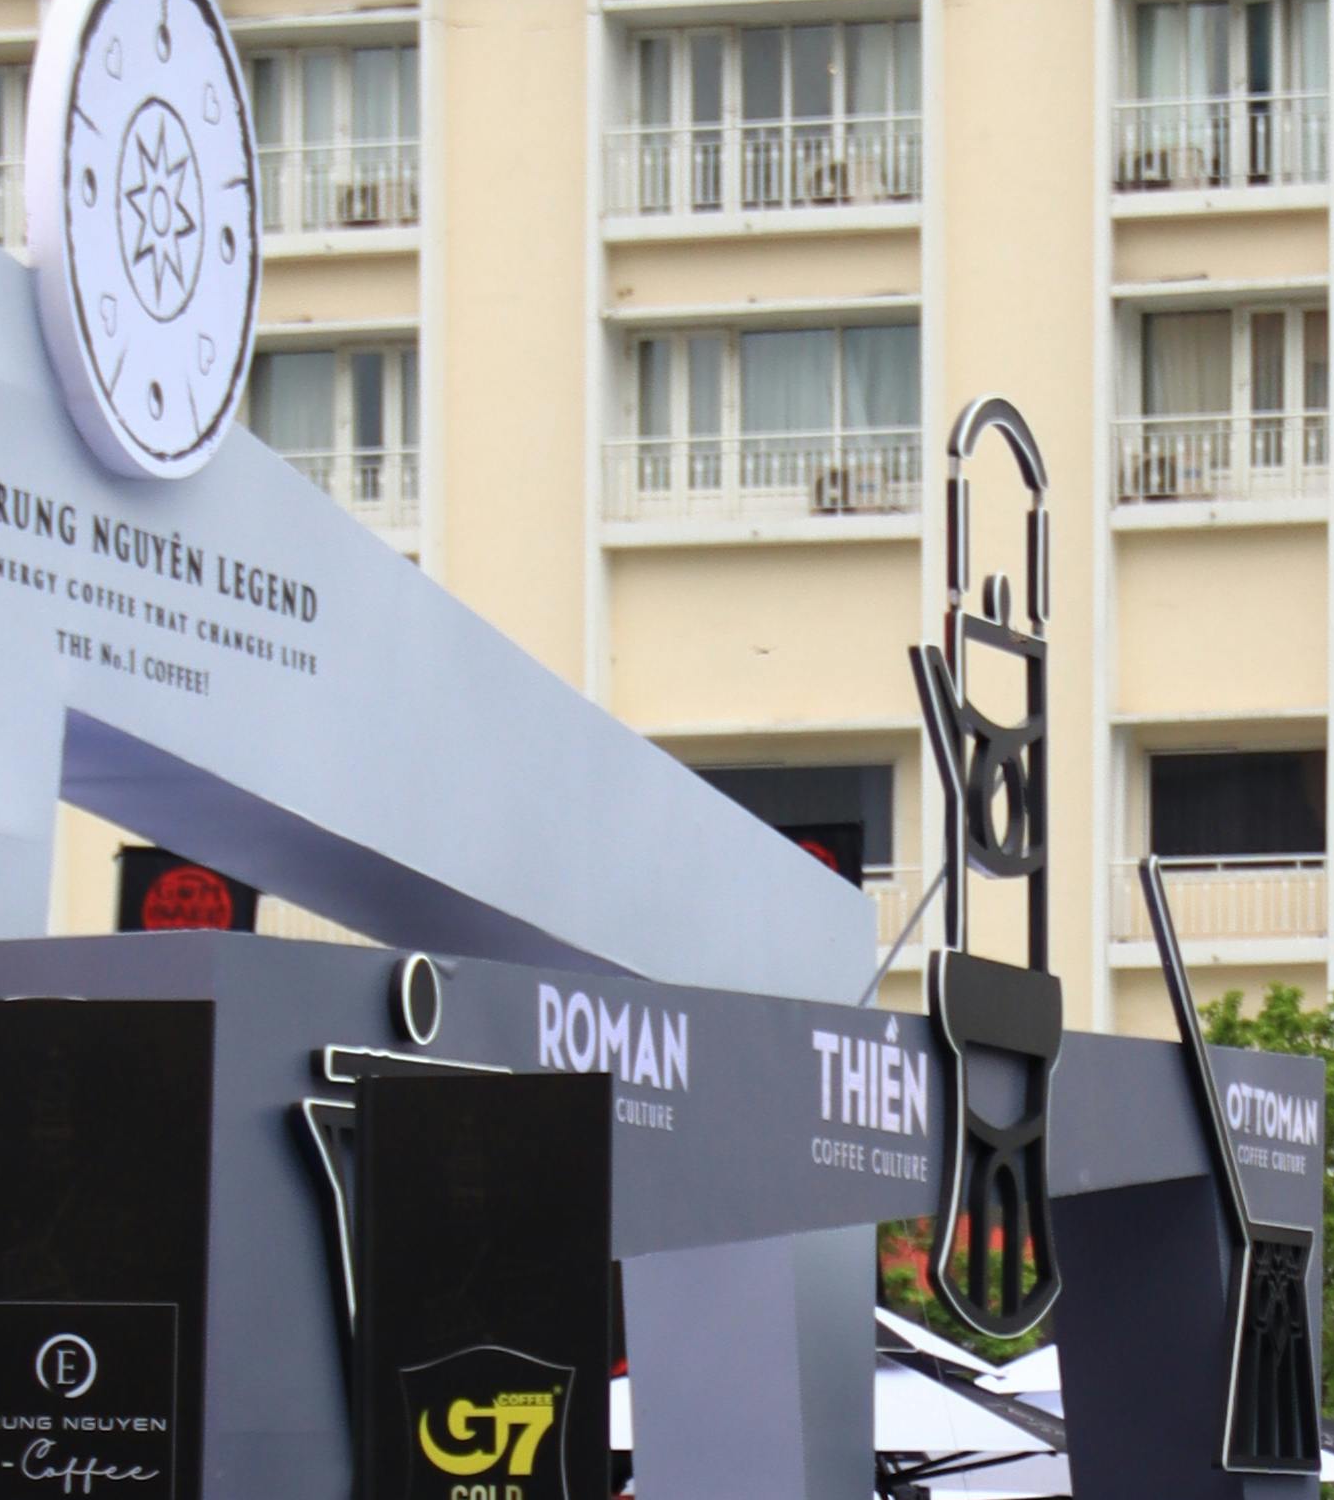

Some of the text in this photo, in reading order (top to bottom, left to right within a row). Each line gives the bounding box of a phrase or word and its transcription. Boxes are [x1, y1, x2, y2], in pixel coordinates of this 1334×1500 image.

[93, 514, 204, 586] NGUYÊN
[217, 555, 318, 623] LEGEND
[68, 578, 135, 617] COFFEE
[144, 602, 187, 635] THAT
[196, 619, 273, 661] CHANGES
[281, 646, 317, 675] LIFE
[56, 629, 210, 695] THE No.1 COFFEE!
[537, 981, 689, 1092] ROMAN
[615, 1098, 674, 1132] CULTURE
[1227, 1082, 1318, 1145] OTTOMAN
[812, 1137, 929, 1182] COFFEE CULTURE
[1238, 1145, 1306, 1175] COFFEE CULTURE
[63, 1416, 167, 1431] NGUYEN
[498, 1393, 554, 1406] COFFEE
[419, 1398, 554, 1476] G7
